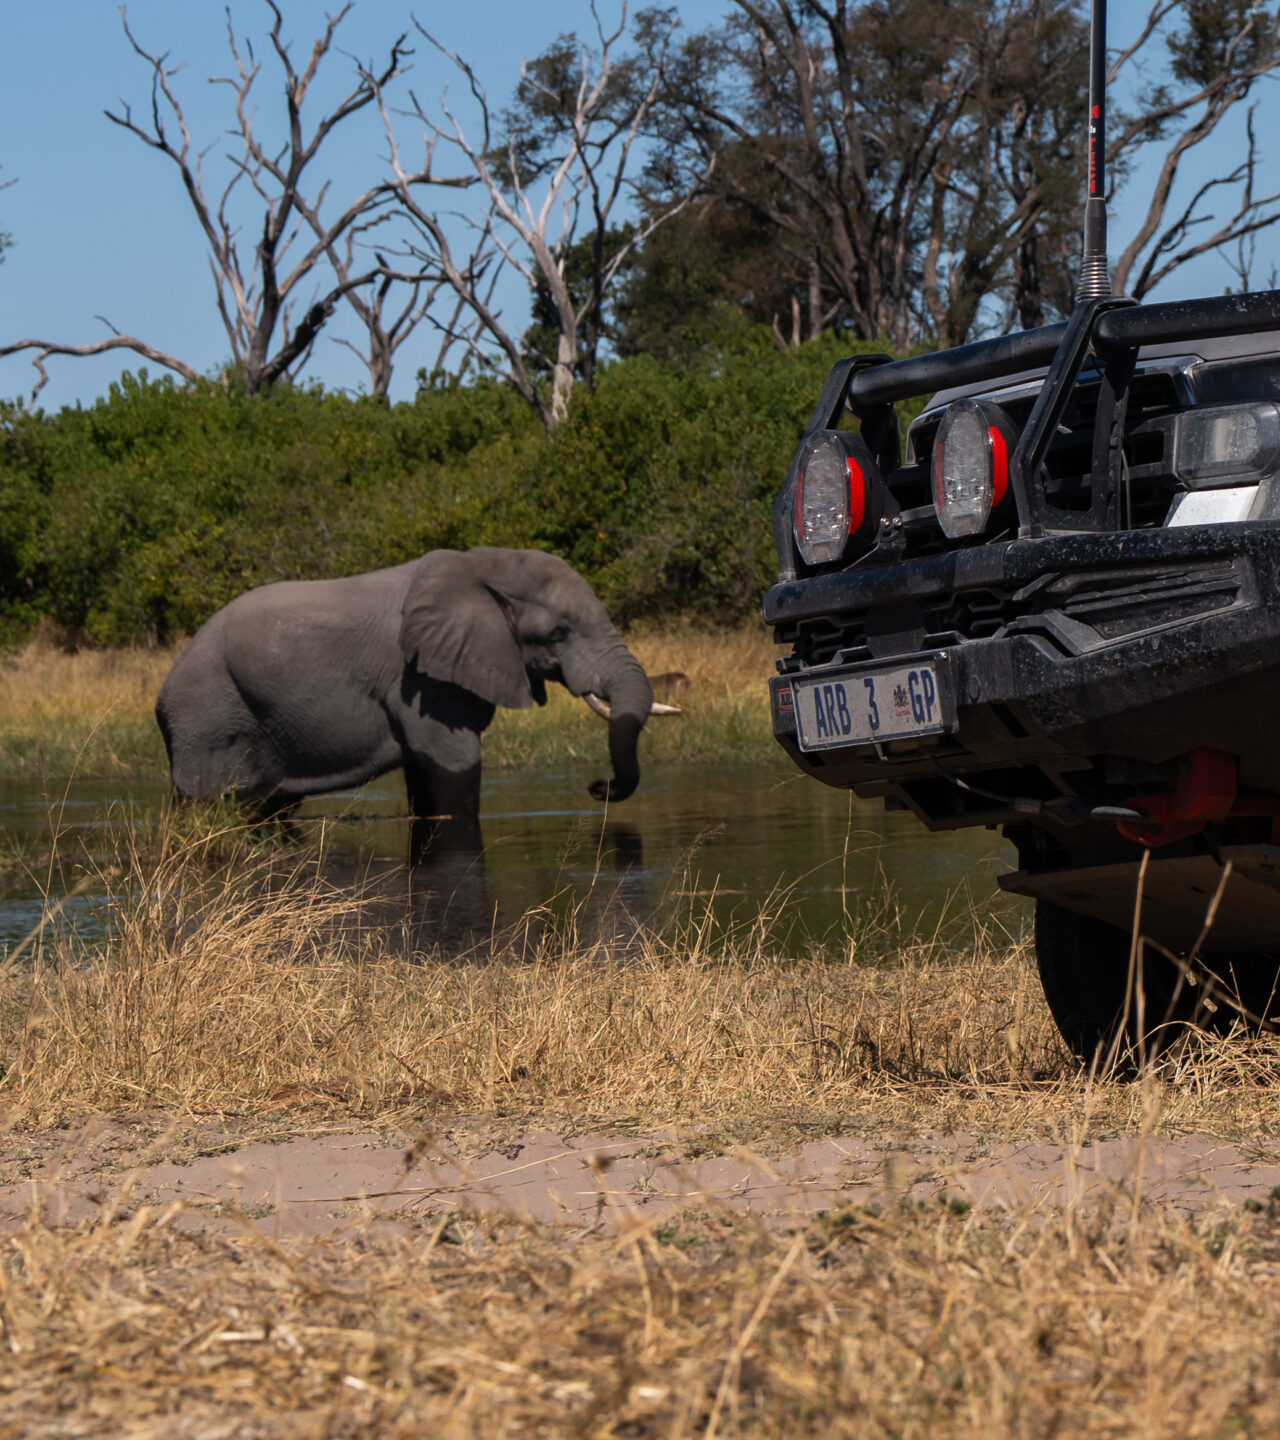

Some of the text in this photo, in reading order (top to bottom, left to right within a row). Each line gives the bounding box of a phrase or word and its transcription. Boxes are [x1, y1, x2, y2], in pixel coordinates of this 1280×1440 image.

[813, 669, 936, 738] ARB 3 GP
